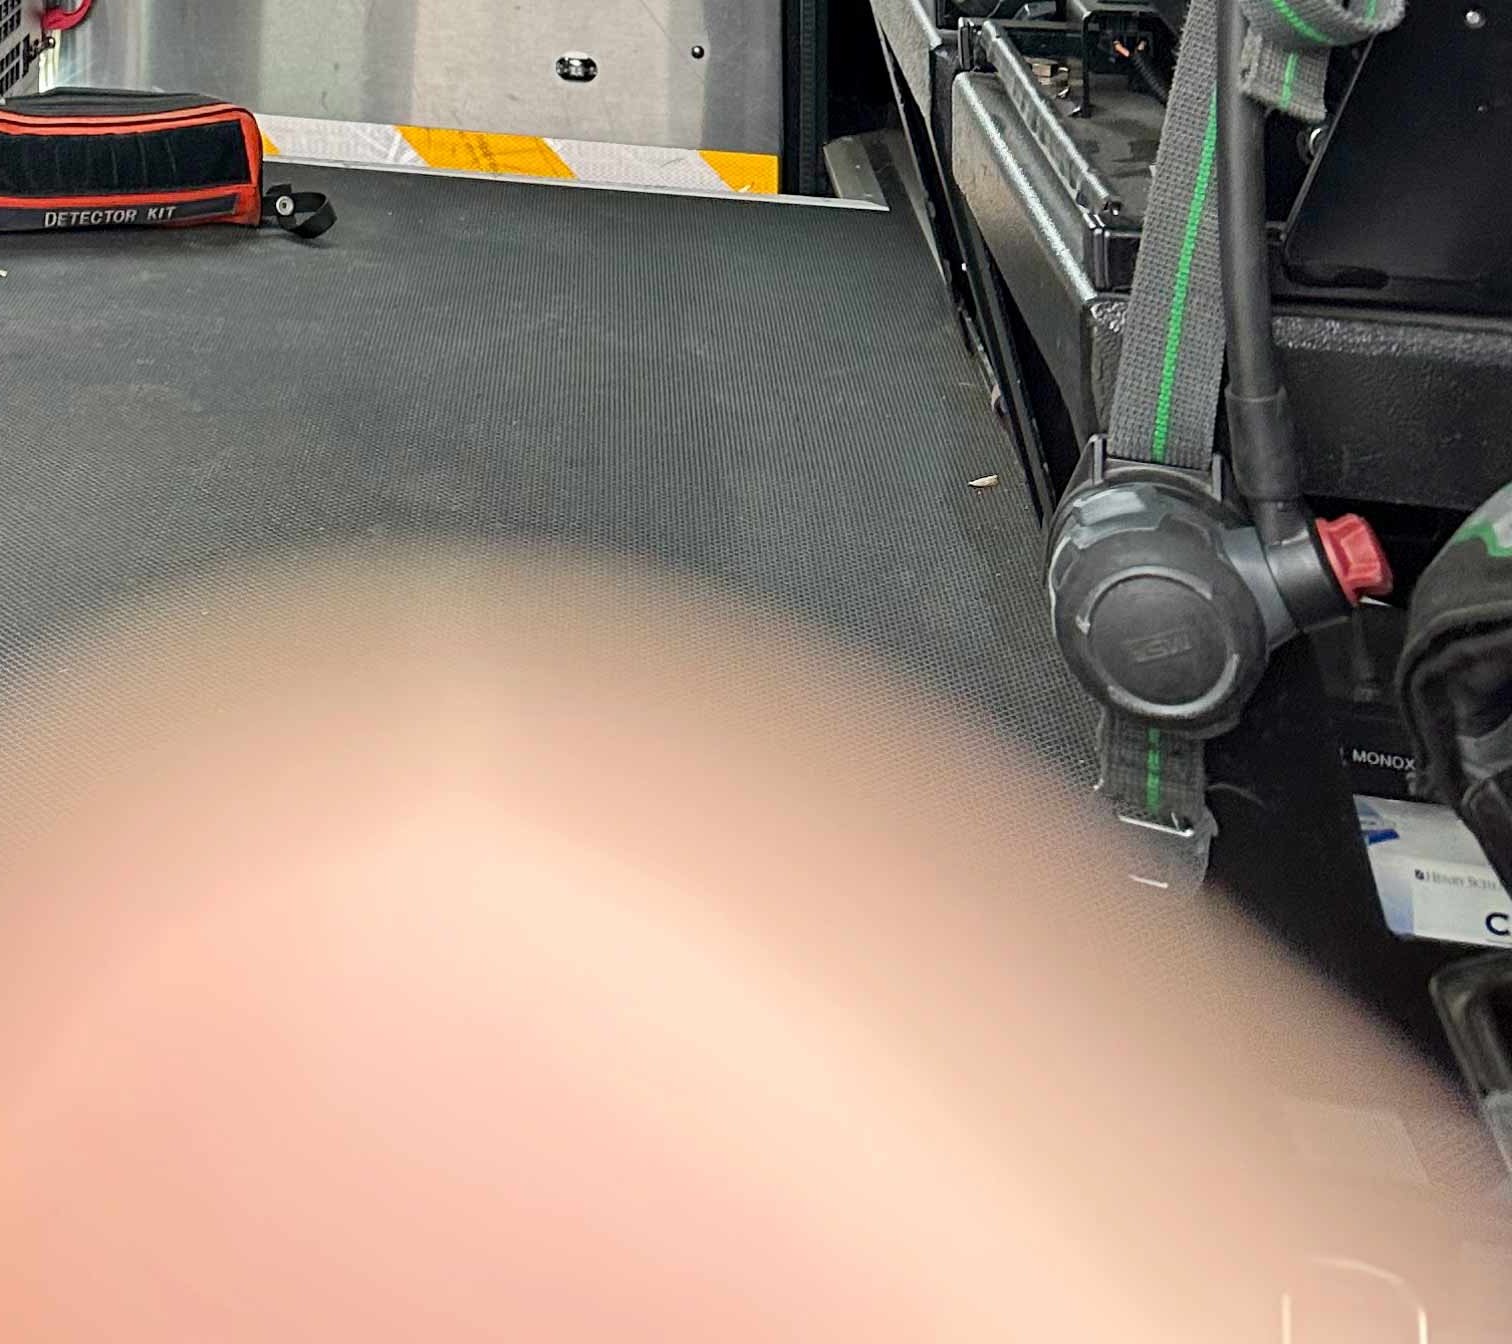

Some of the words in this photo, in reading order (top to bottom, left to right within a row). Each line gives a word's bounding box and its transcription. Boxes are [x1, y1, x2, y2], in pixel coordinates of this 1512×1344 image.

[44, 209, 137, 228] DETECTOR
[148, 206, 177, 221] KIT
[1352, 748, 1417, 770] MONOX
